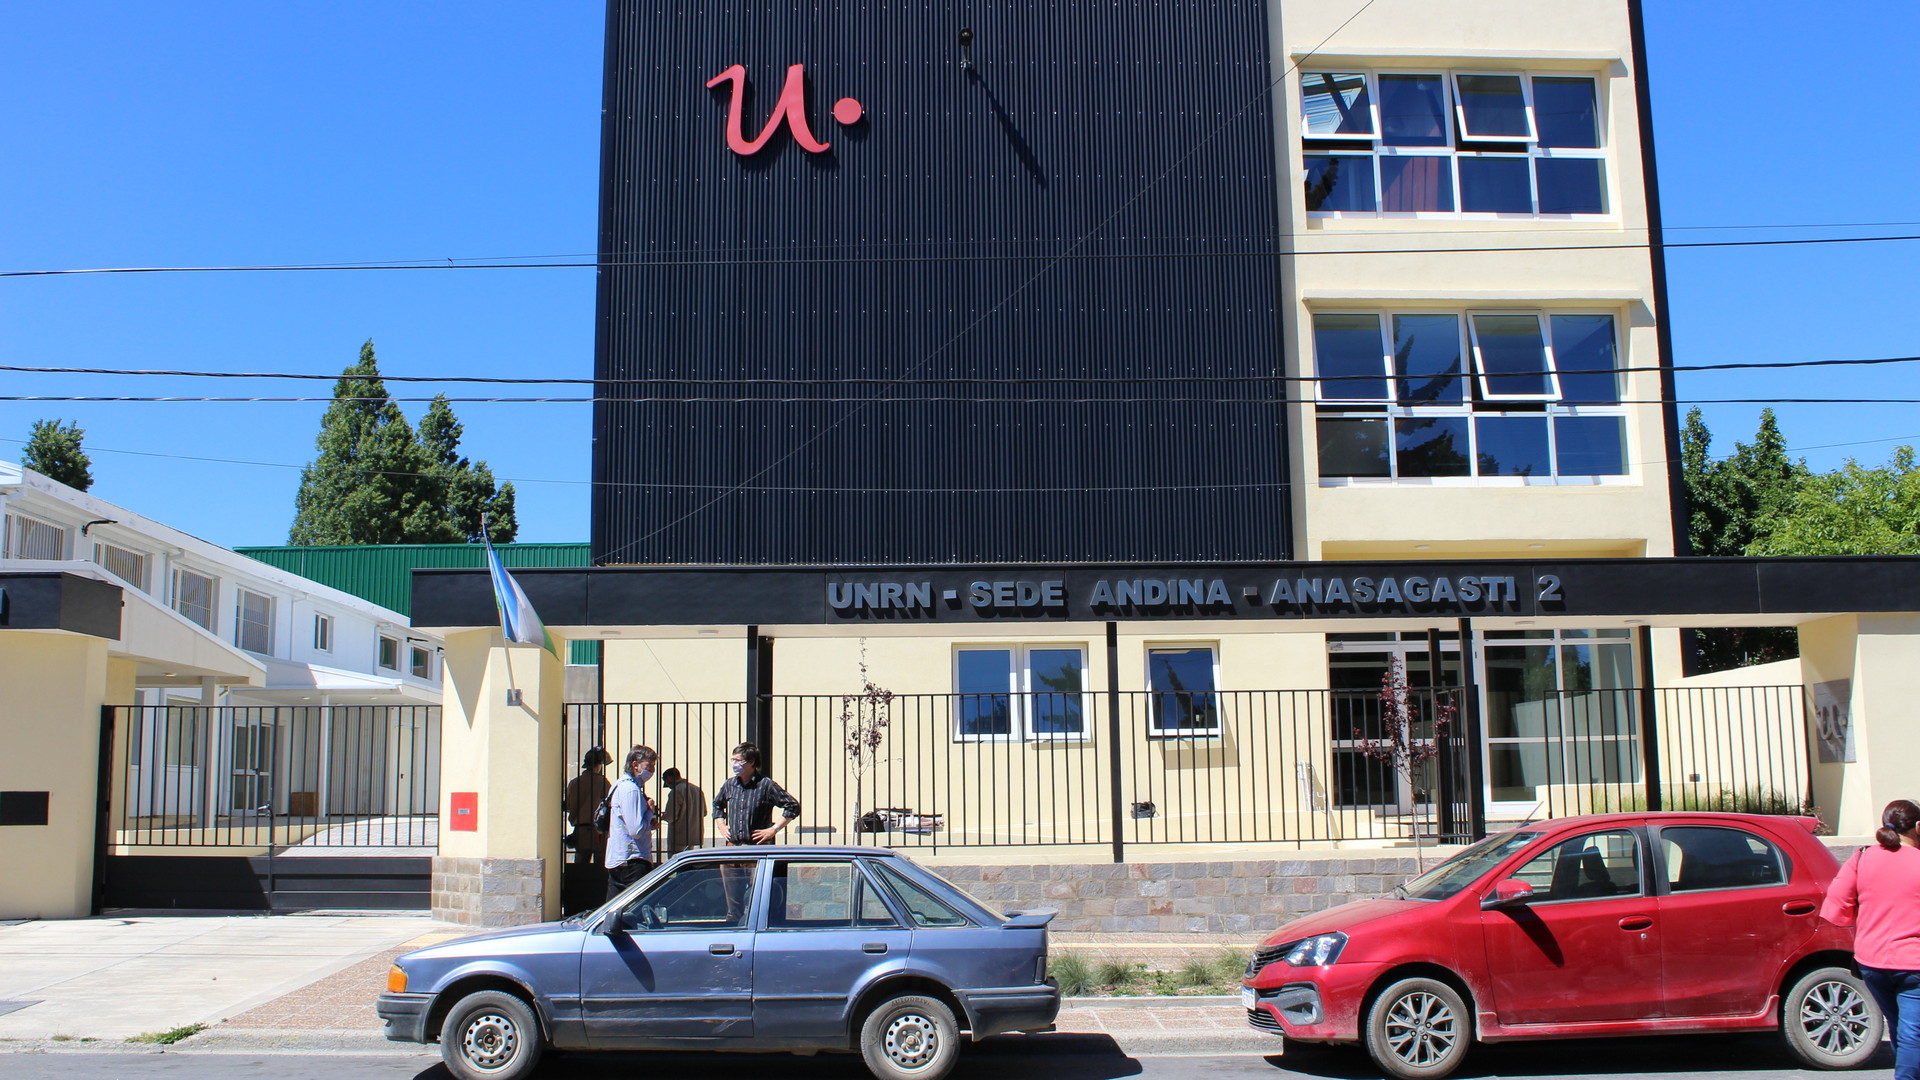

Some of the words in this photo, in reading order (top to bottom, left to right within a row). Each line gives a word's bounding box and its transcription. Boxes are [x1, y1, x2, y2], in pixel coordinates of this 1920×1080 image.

[828, 582, 931, 609] UNRN
[969, 580, 1064, 607] SEDE
[1089, 578, 1233, 606] ANDINA
[1269, 576, 1517, 605] ANASAGASTI
[1537, 574, 1562, 601] 2
